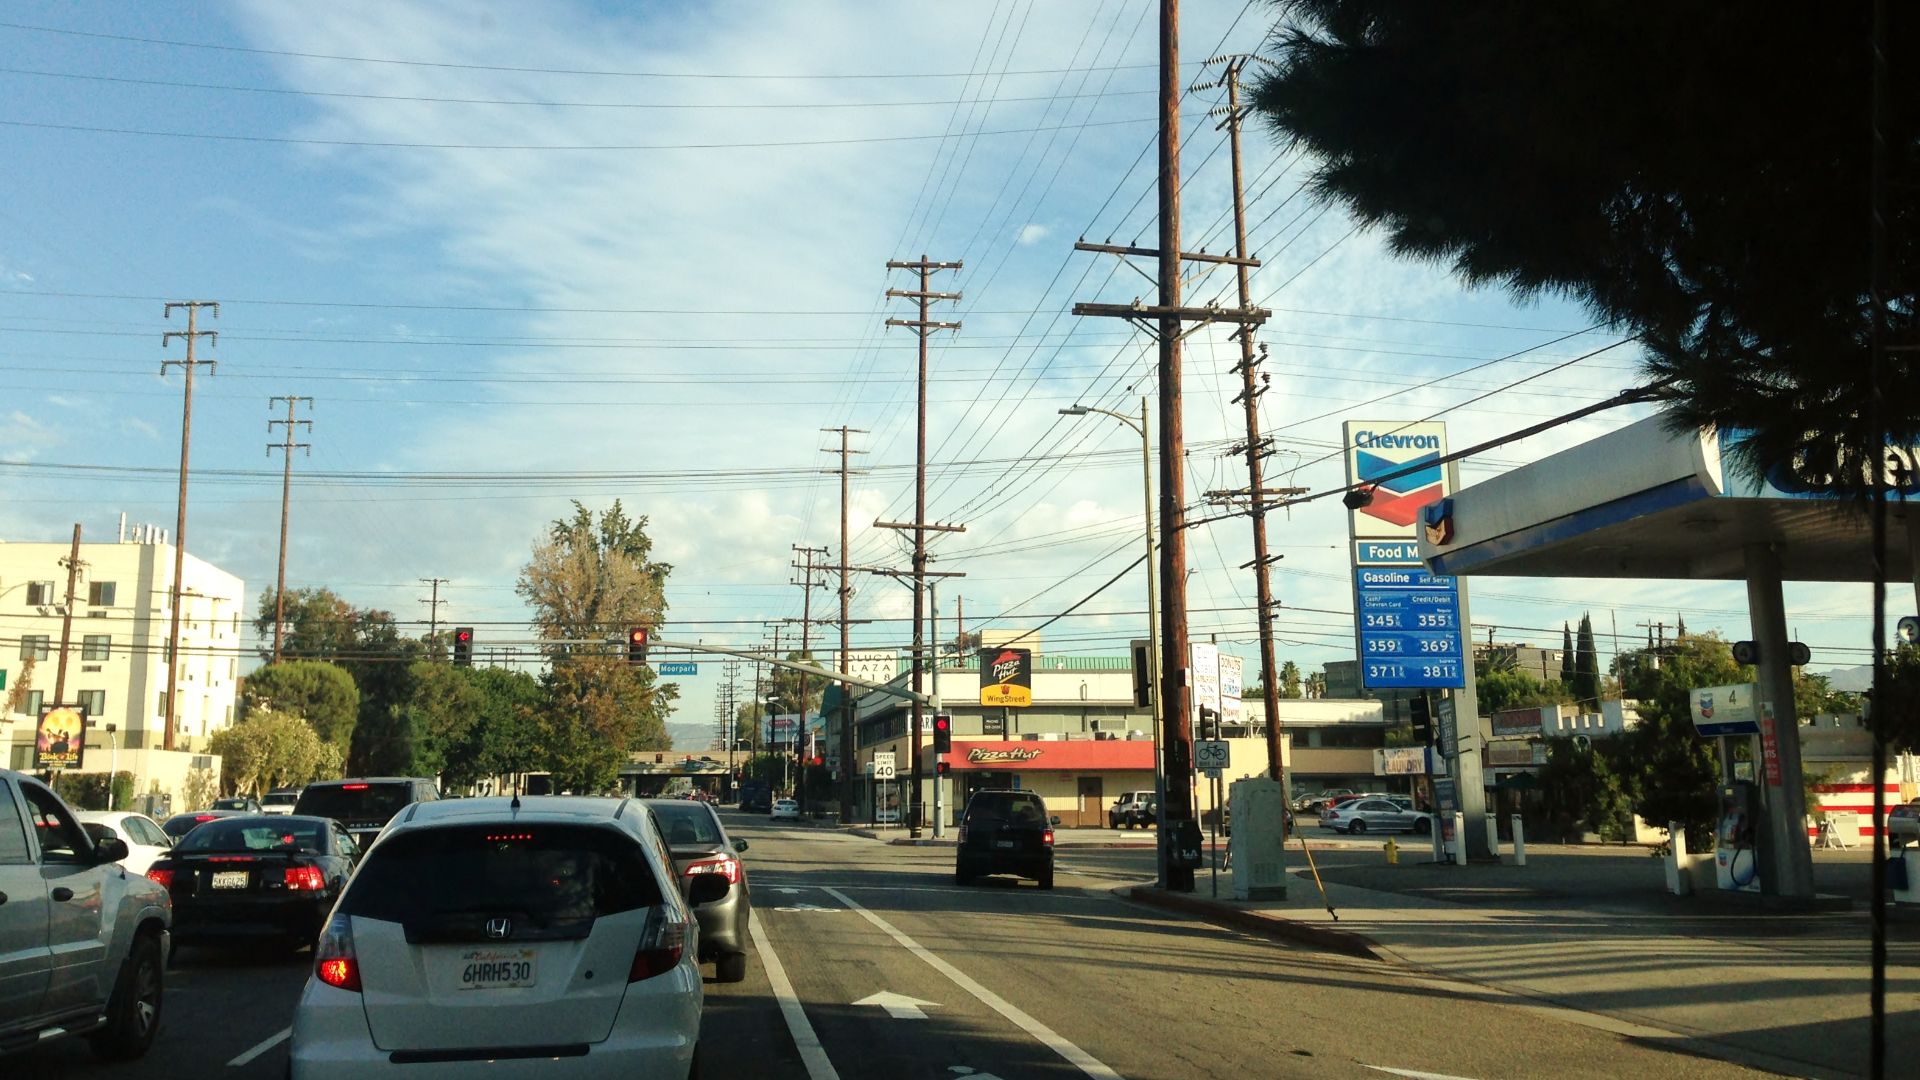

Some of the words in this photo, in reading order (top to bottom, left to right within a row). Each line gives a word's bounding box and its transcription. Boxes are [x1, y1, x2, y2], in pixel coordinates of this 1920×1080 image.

[1355, 431, 1440, 449] Chevron
[1369, 546, 1402, 558] Food
[1363, 572, 1410, 583] Gasoline
[1366, 615, 1394, 627] 345
[1418, 615, 1447, 627] 355
[1368, 640, 1396, 652] 359
[1421, 640, 1449, 652] 369
[846, 653, 893, 662] OLUCA
[660, 665, 696, 673] Moorpark
[992, 660, 1020, 677] Pizza
[998, 667, 1018, 680] Hut
[1370, 666, 1396, 677] 371
[1423, 666, 1449, 677] 381
[987, 695, 1026, 704] WingStreet
[1728, 689, 1737, 704] 4
[967, 748, 1008, 761] Pizza
[1009, 747, 1042, 759] Hut
[876, 766, 894, 776] 40
[462, 962, 531, 983] 6HRH530
